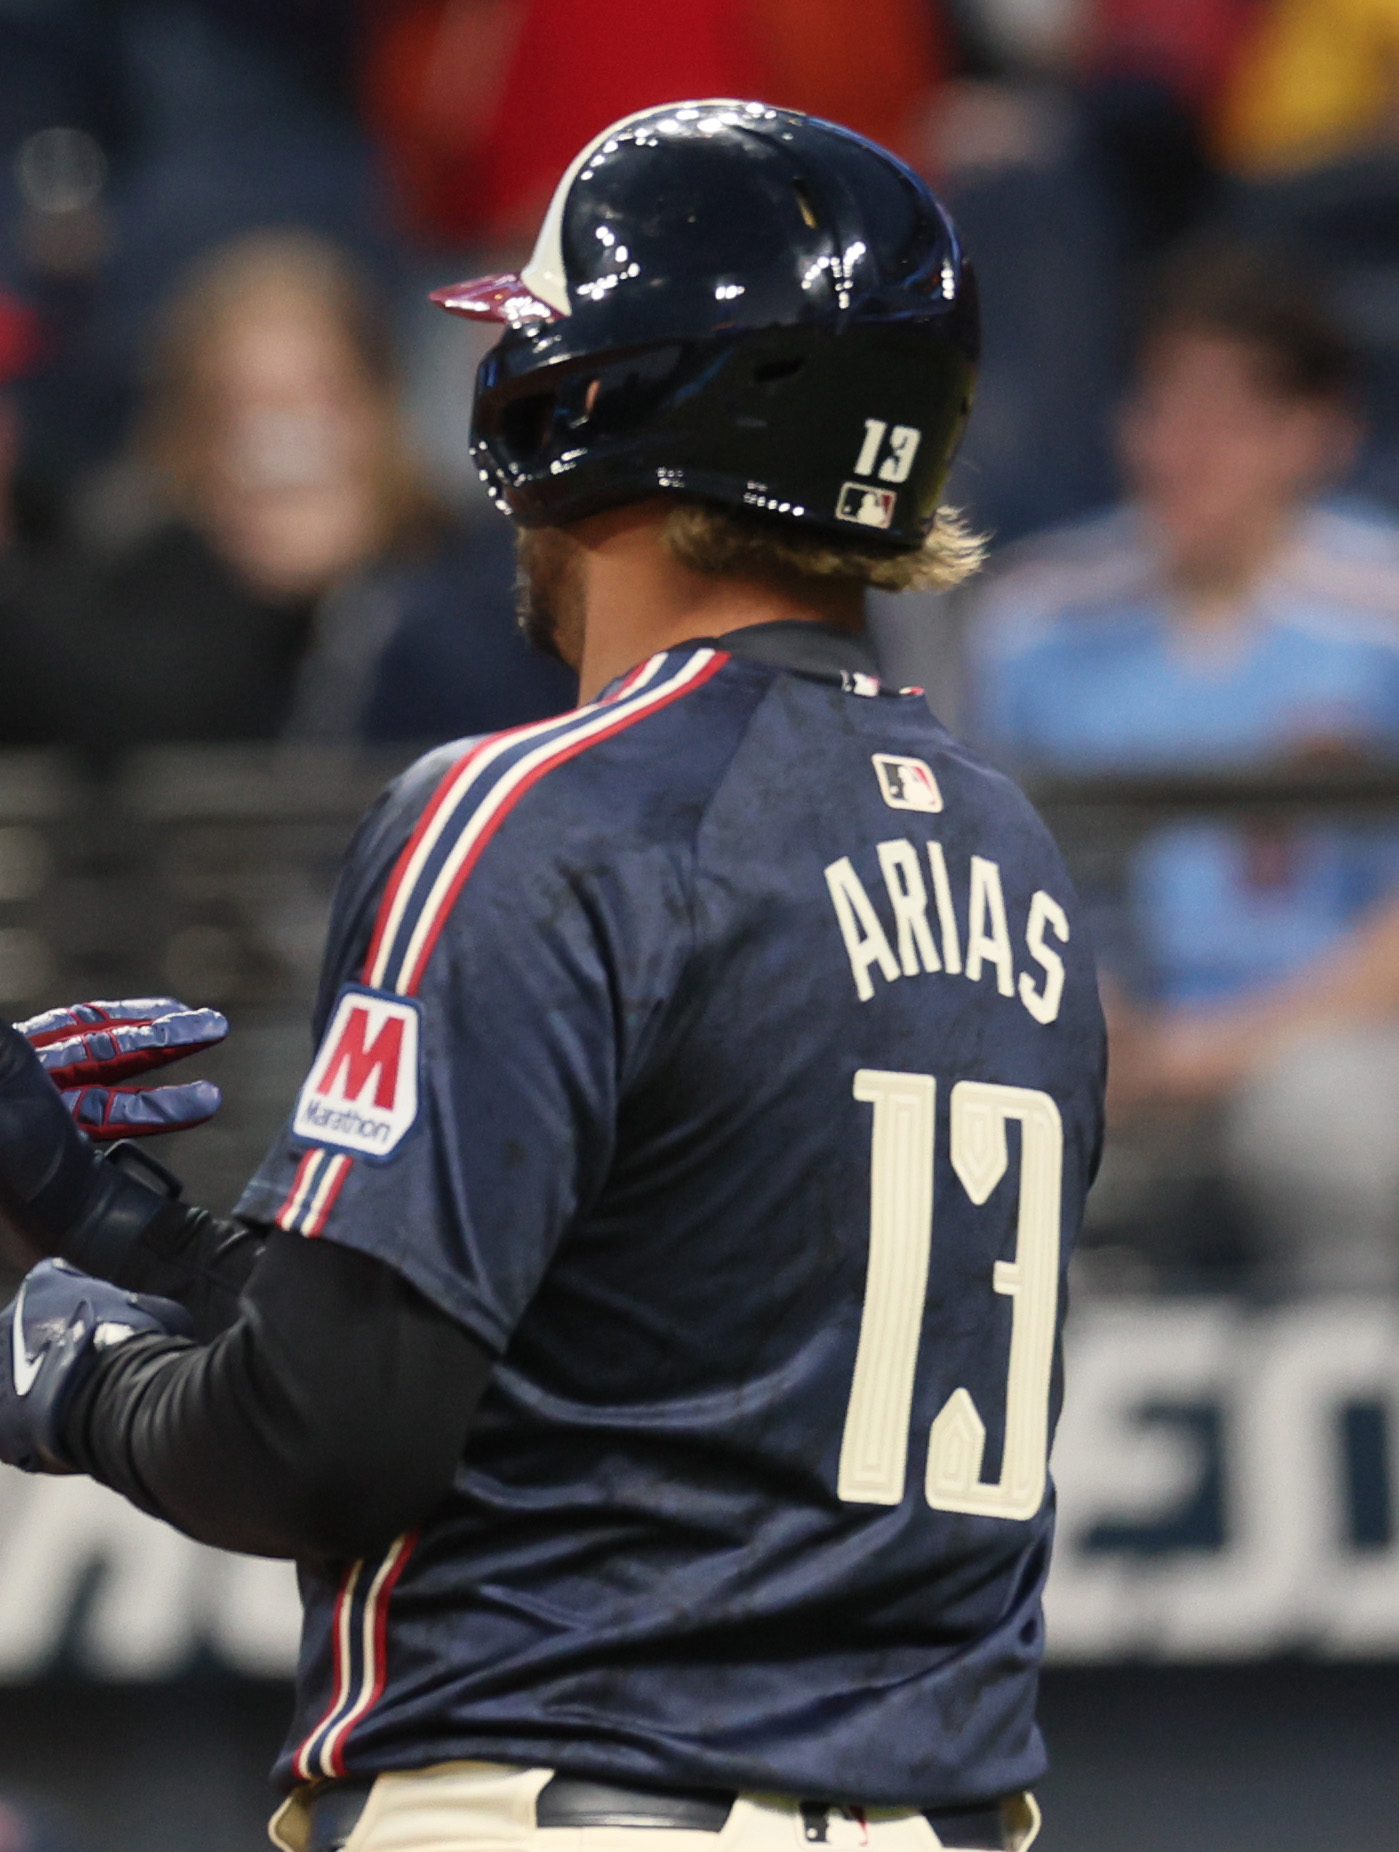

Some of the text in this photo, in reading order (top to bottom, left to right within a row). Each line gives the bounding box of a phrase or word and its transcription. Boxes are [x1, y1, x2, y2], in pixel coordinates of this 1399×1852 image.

[854, 418, 921, 483] 13
[824, 839, 1069, 1025] ARIAS
[316, 1006, 405, 1112] M
[304, 1099, 391, 1143] Marathon
[838, 1069, 1062, 1520] 13
